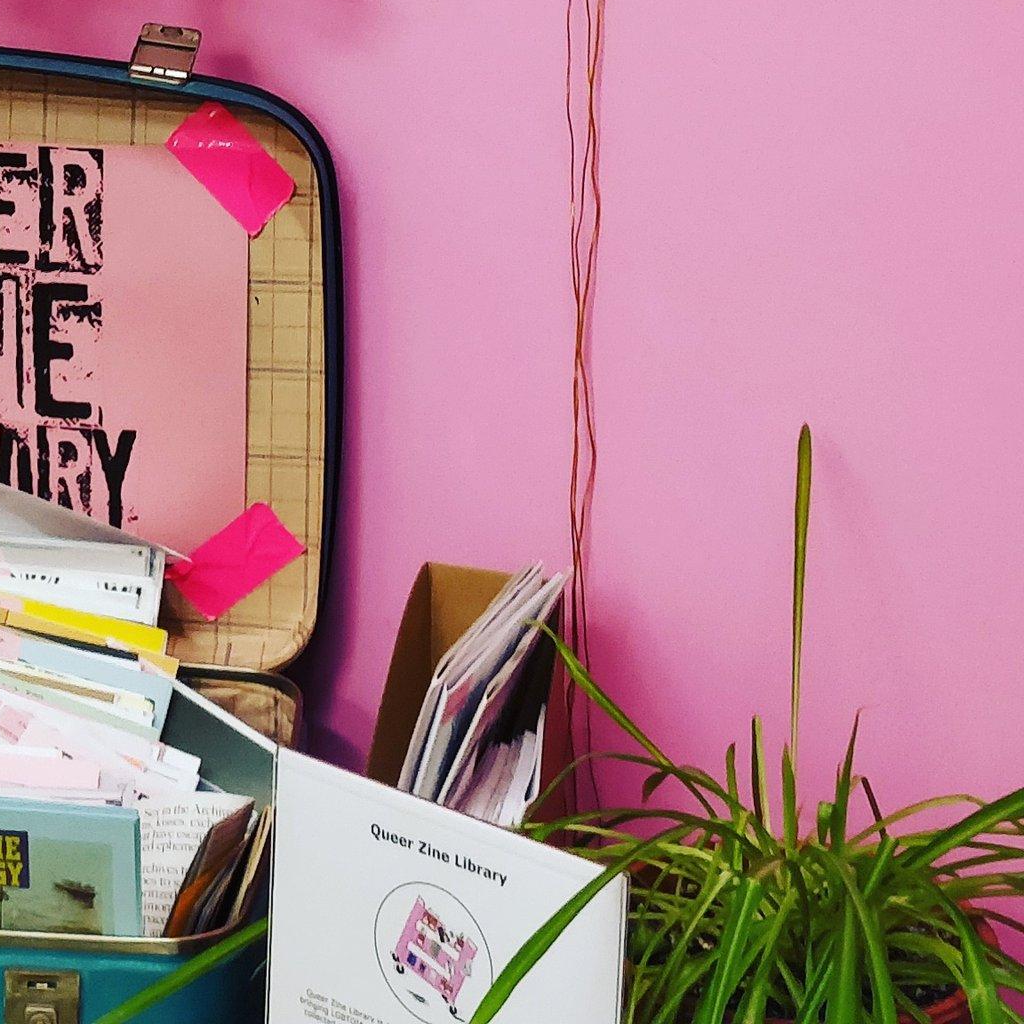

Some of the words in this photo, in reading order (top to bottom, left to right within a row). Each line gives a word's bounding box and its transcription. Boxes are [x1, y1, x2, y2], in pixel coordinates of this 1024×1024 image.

[370, 823, 414, 851] Queer
[418, 840, 450, 864] Zine
[455, 854, 508, 887] Library
